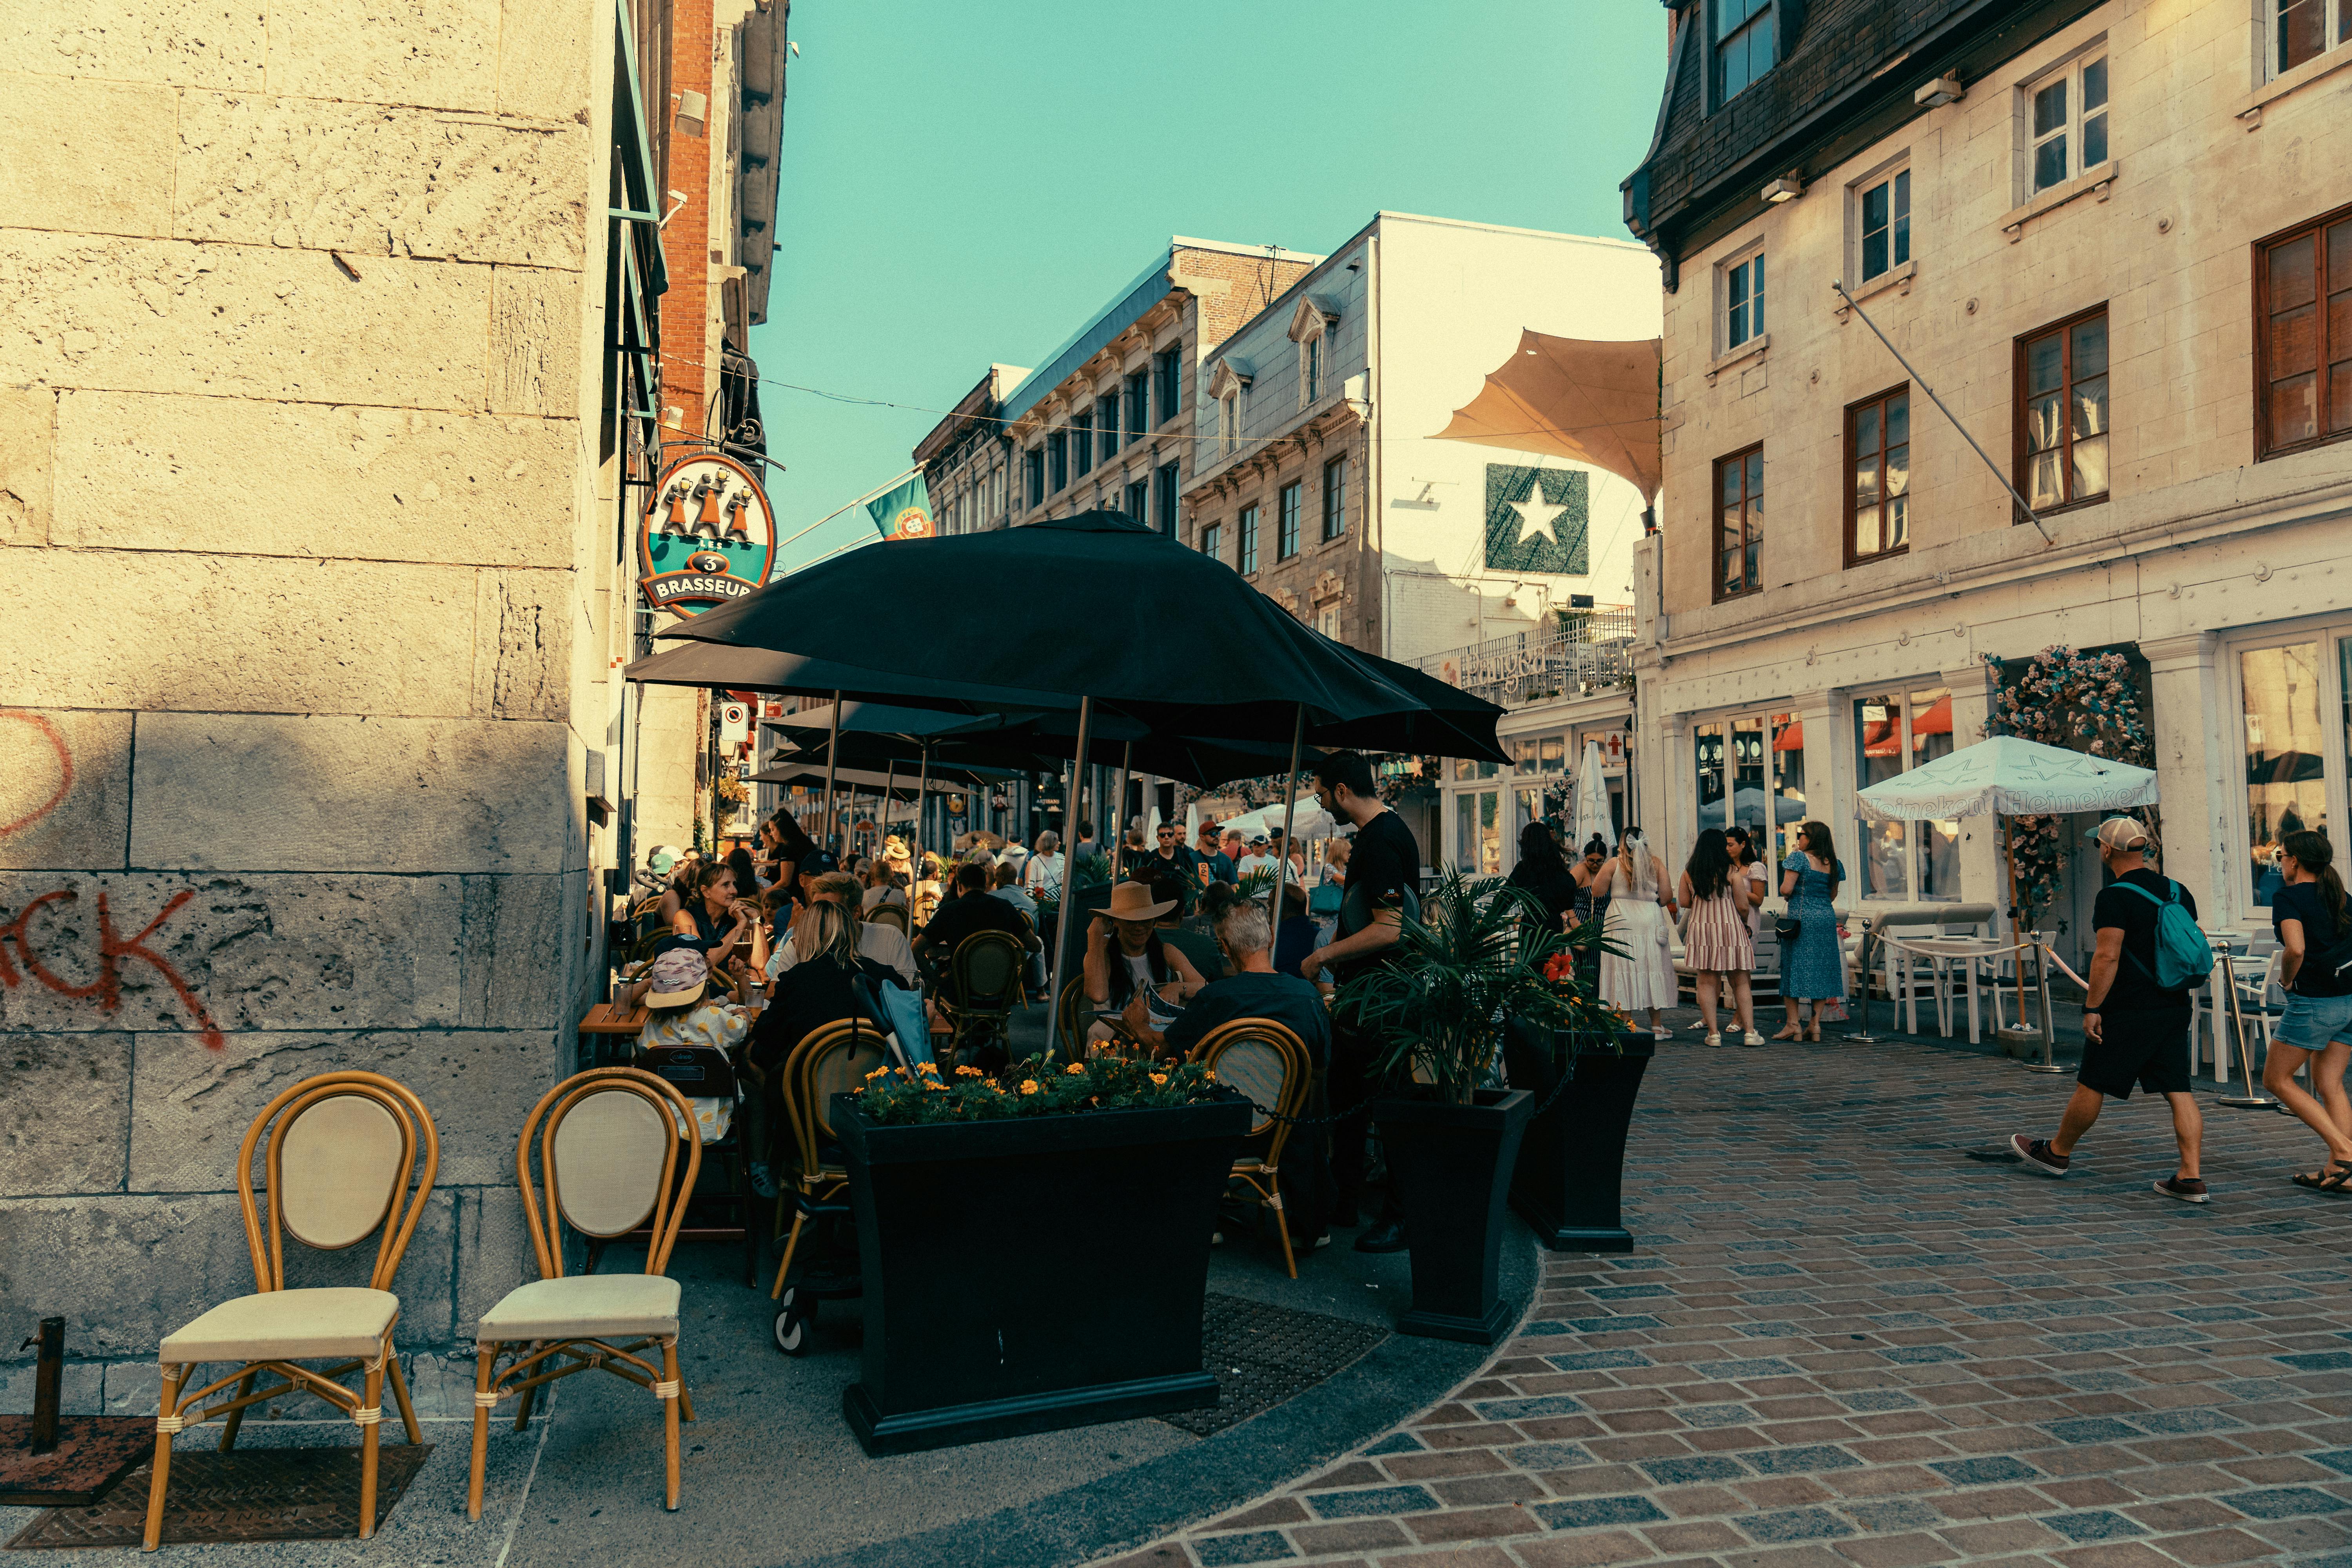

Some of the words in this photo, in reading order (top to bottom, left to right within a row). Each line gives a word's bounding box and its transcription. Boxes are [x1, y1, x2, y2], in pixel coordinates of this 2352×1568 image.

[700, 540, 722, 550] LES
[704, 556, 717, 571] 3
[1467, 646, 1547, 693] Pangea
